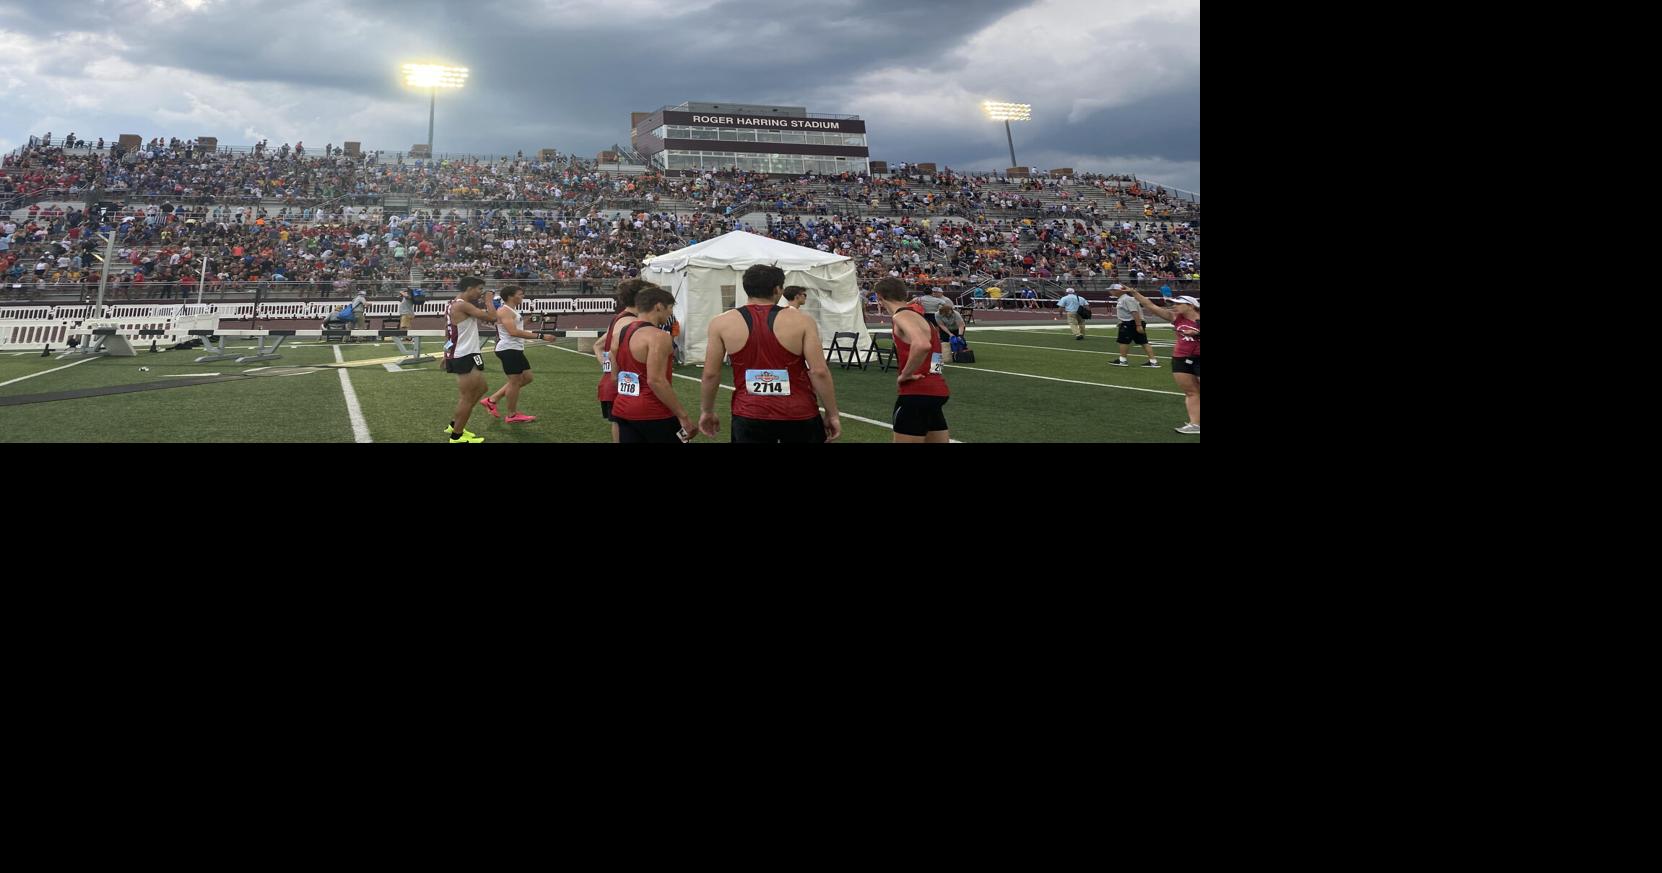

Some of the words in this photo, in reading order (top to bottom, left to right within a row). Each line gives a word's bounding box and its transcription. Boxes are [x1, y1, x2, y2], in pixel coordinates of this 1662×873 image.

[692, 115, 734, 125] ROGER
[736, 117, 788, 127] HARRING
[790, 120, 840, 129] STADIUM
[620, 382, 636, 393] 2718
[753, 381, 783, 393] 2714
